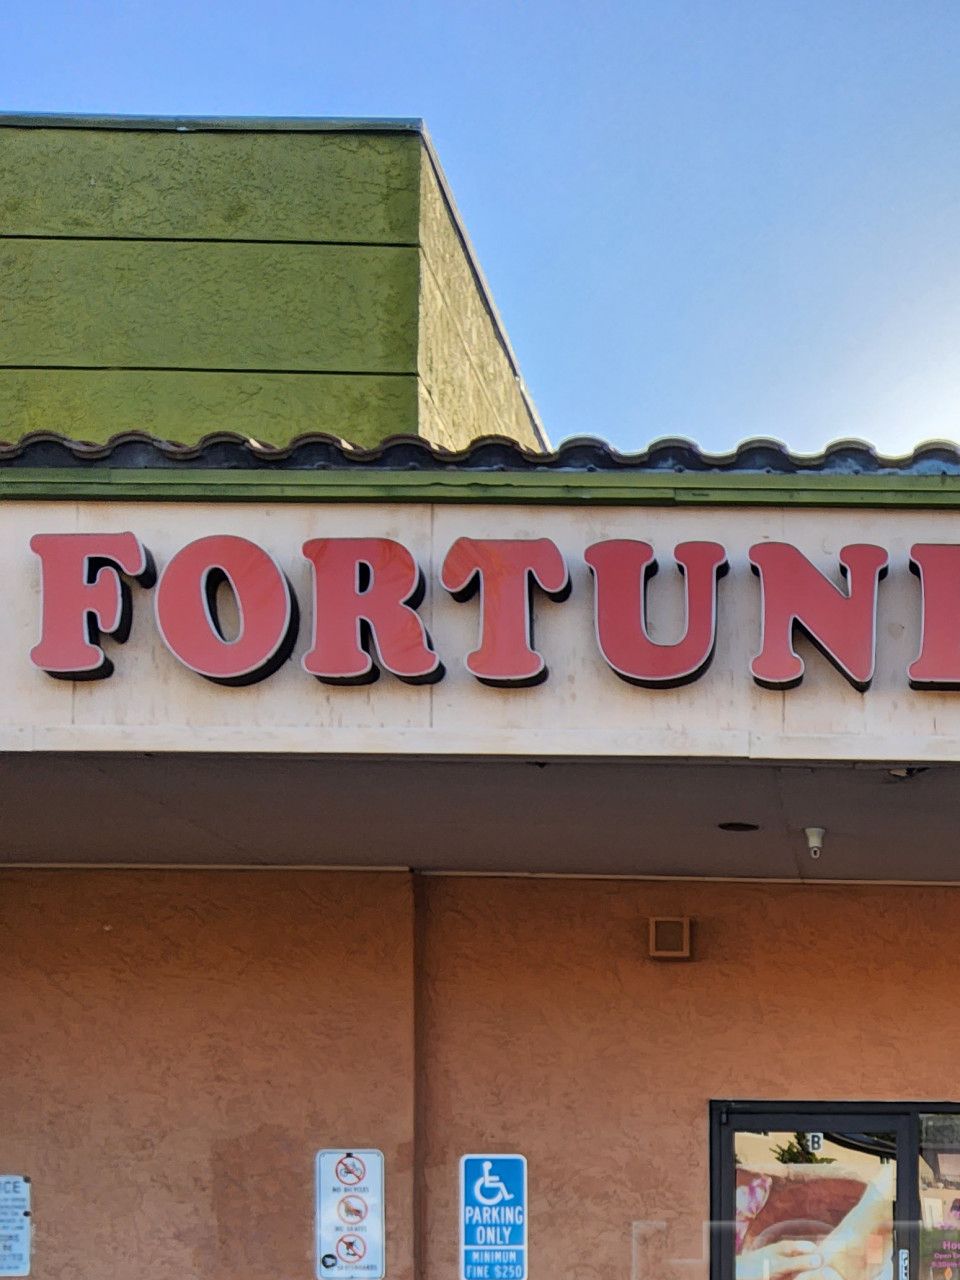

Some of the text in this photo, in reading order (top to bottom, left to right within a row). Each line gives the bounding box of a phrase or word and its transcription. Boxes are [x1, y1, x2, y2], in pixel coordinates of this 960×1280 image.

[811, 1134, 822, 1151] B
[465, 1205, 524, 1225] PARKING
[476, 1225, 512, 1245] ONLY
[471, 1250, 517, 1264] MINIMUM
[466, 1264, 522, 1279] FINE $250
